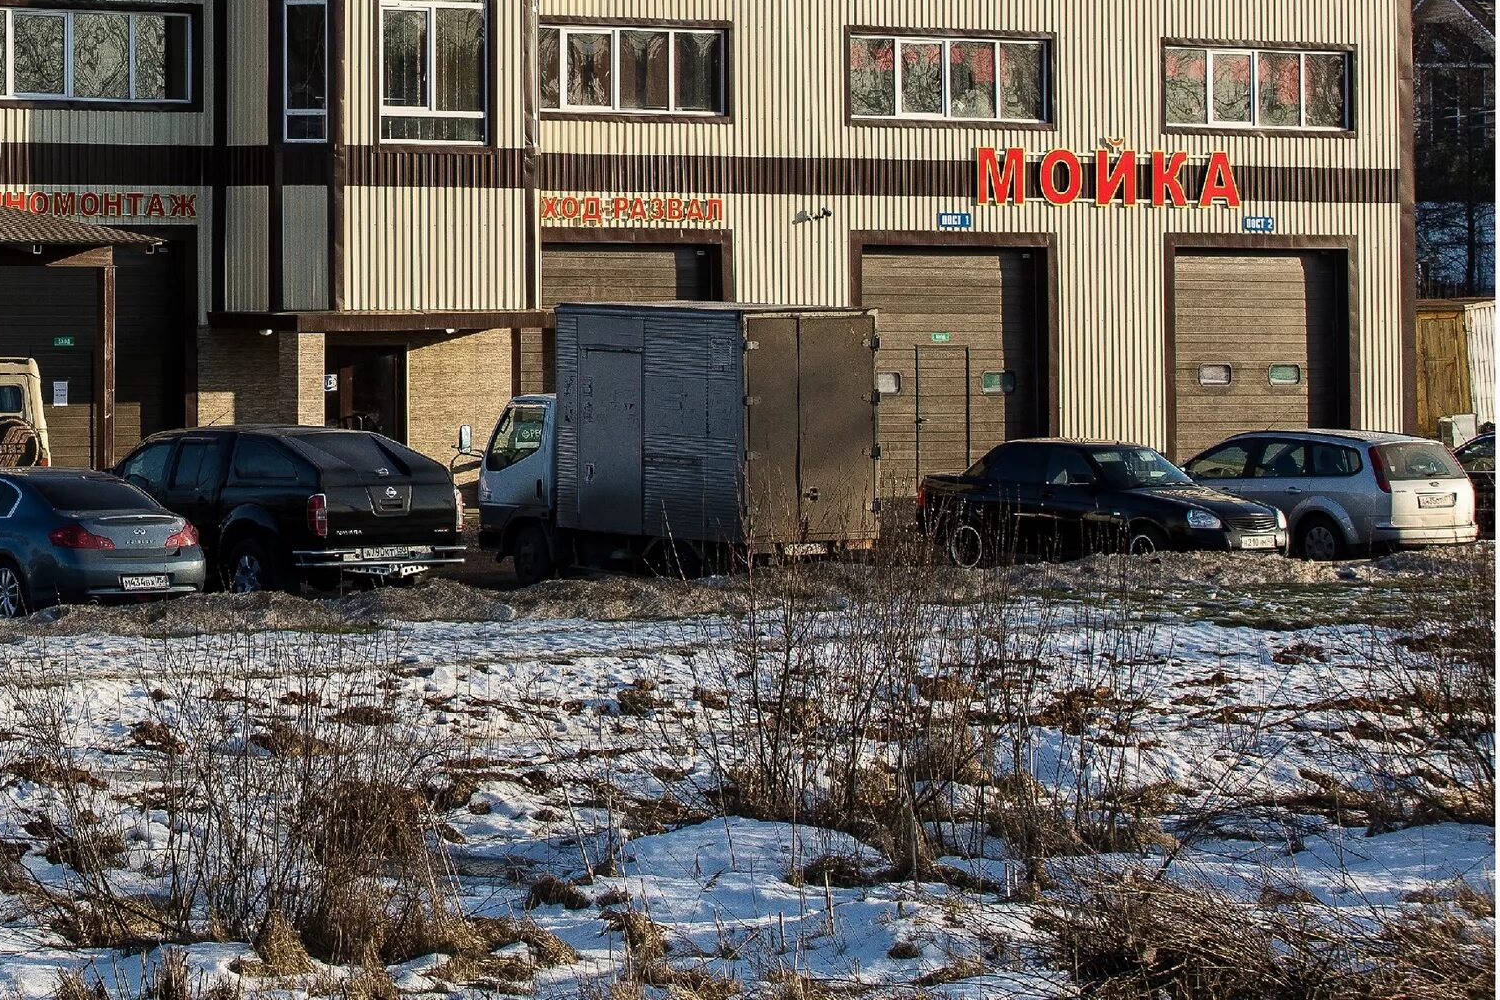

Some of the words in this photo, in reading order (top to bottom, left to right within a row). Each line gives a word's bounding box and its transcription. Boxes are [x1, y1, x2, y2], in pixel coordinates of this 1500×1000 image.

[976, 136, 1241, 208] МОЙКА
[941, 214, 961, 225] ПОСТ
[965, 214, 970, 225] 1
[1246, 218, 1264, 229] ПОСТ
[1267, 218, 1273, 229] 2
